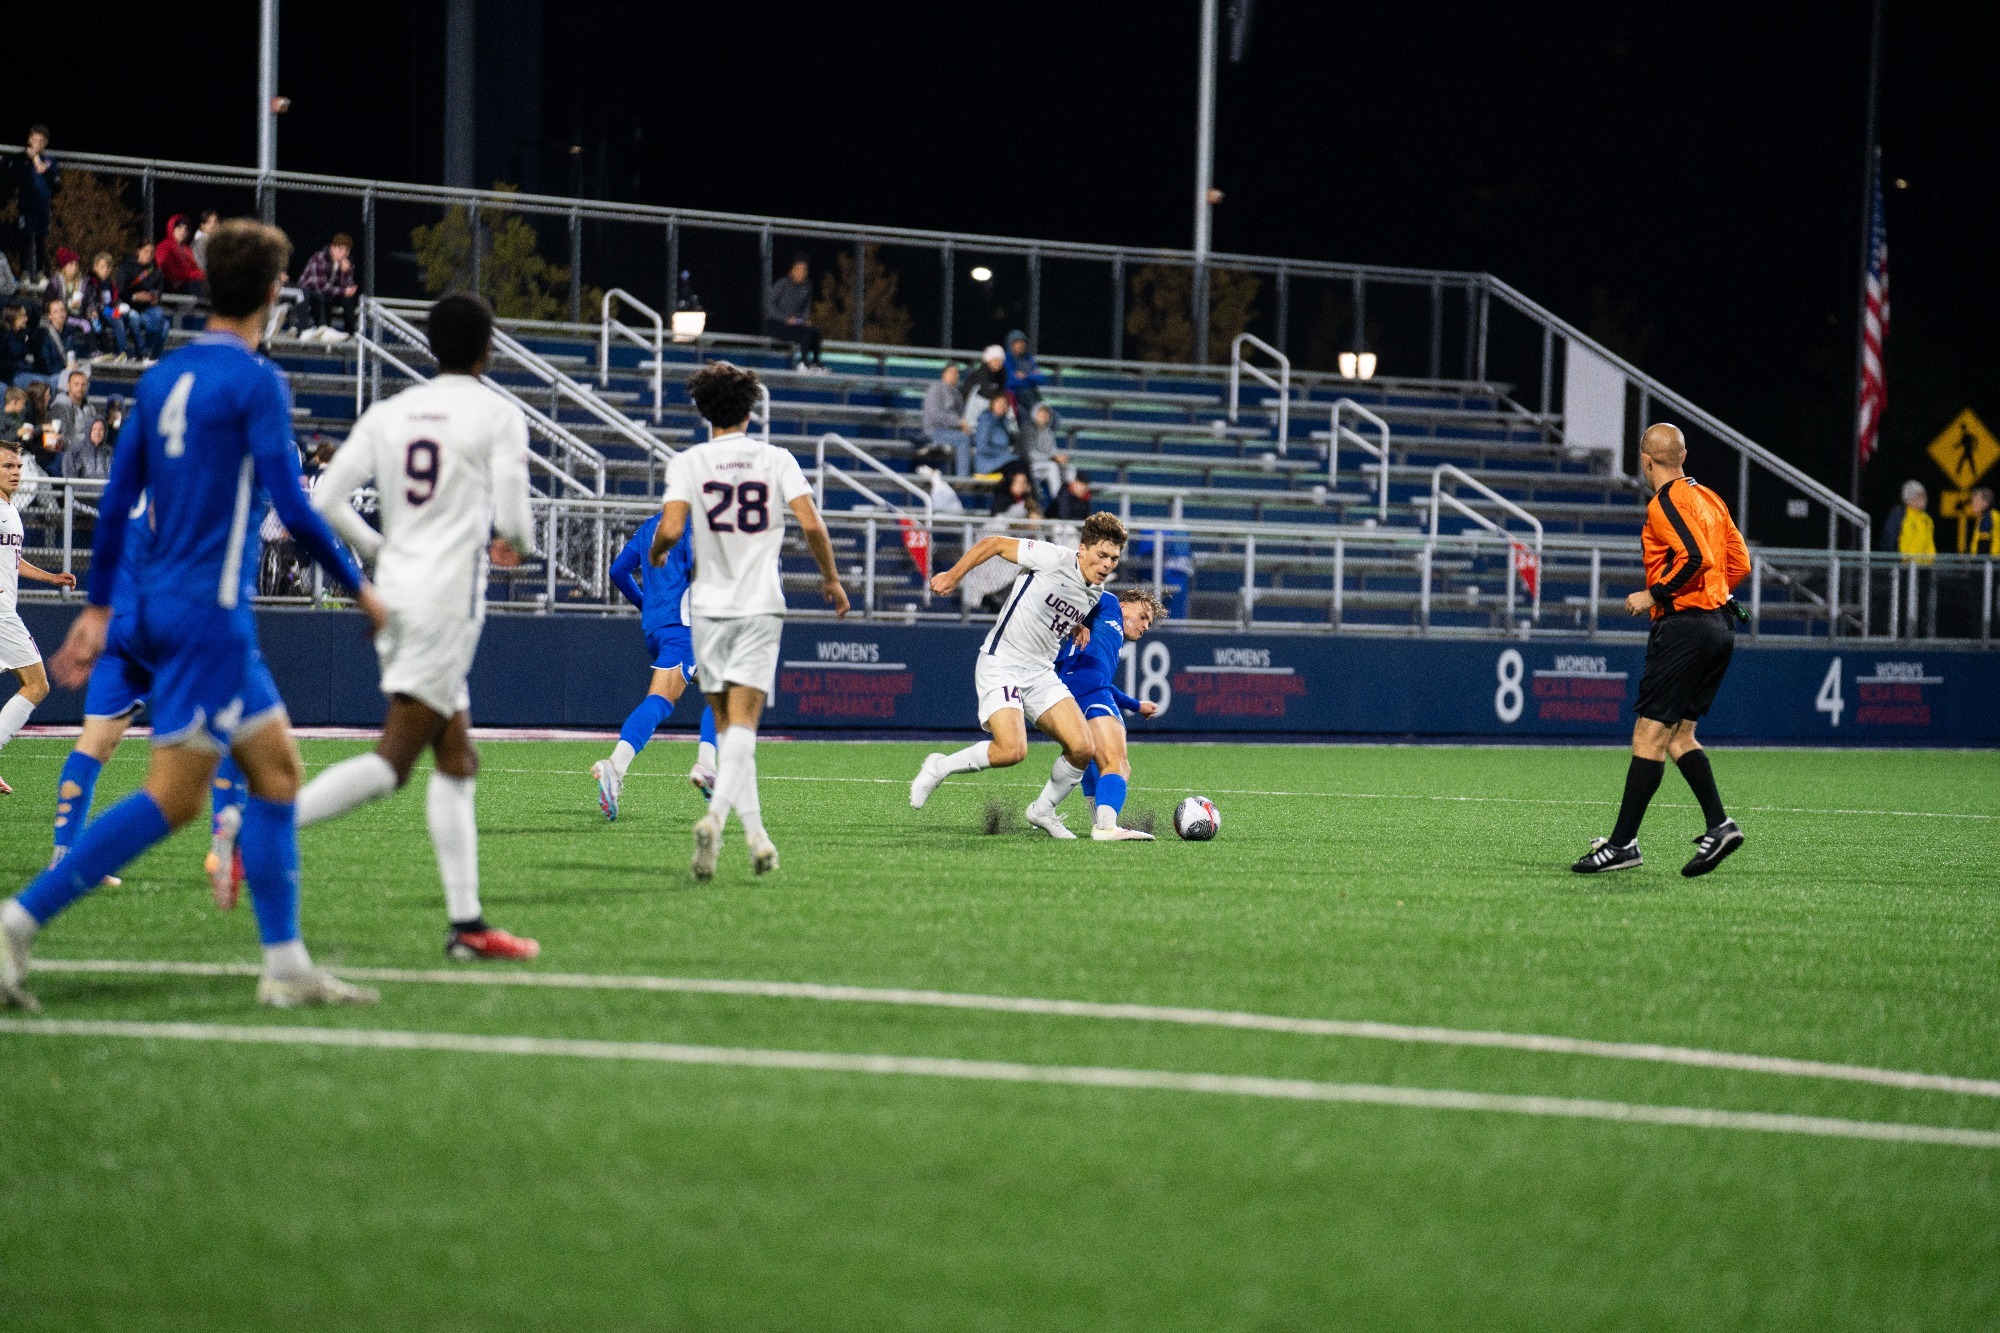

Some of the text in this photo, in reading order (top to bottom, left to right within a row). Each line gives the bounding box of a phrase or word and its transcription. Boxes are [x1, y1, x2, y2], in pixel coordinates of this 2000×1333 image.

[157, 371, 196, 458] 4
[406, 439, 441, 506] 9
[703, 481, 769, 534] 28
[1049, 614, 1070, 636] 14
[816, 641, 880, 663] WOMEN'S
[1213, 648, 1271, 667] WOMEN'S
[1554, 655, 1607, 673] WOMEN'S
[1001, 685, 1021, 703] 14
[1120, 640, 1171, 718] 18
[1495, 648, 1525, 723] 8
[1815, 655, 1845, 727] 4
